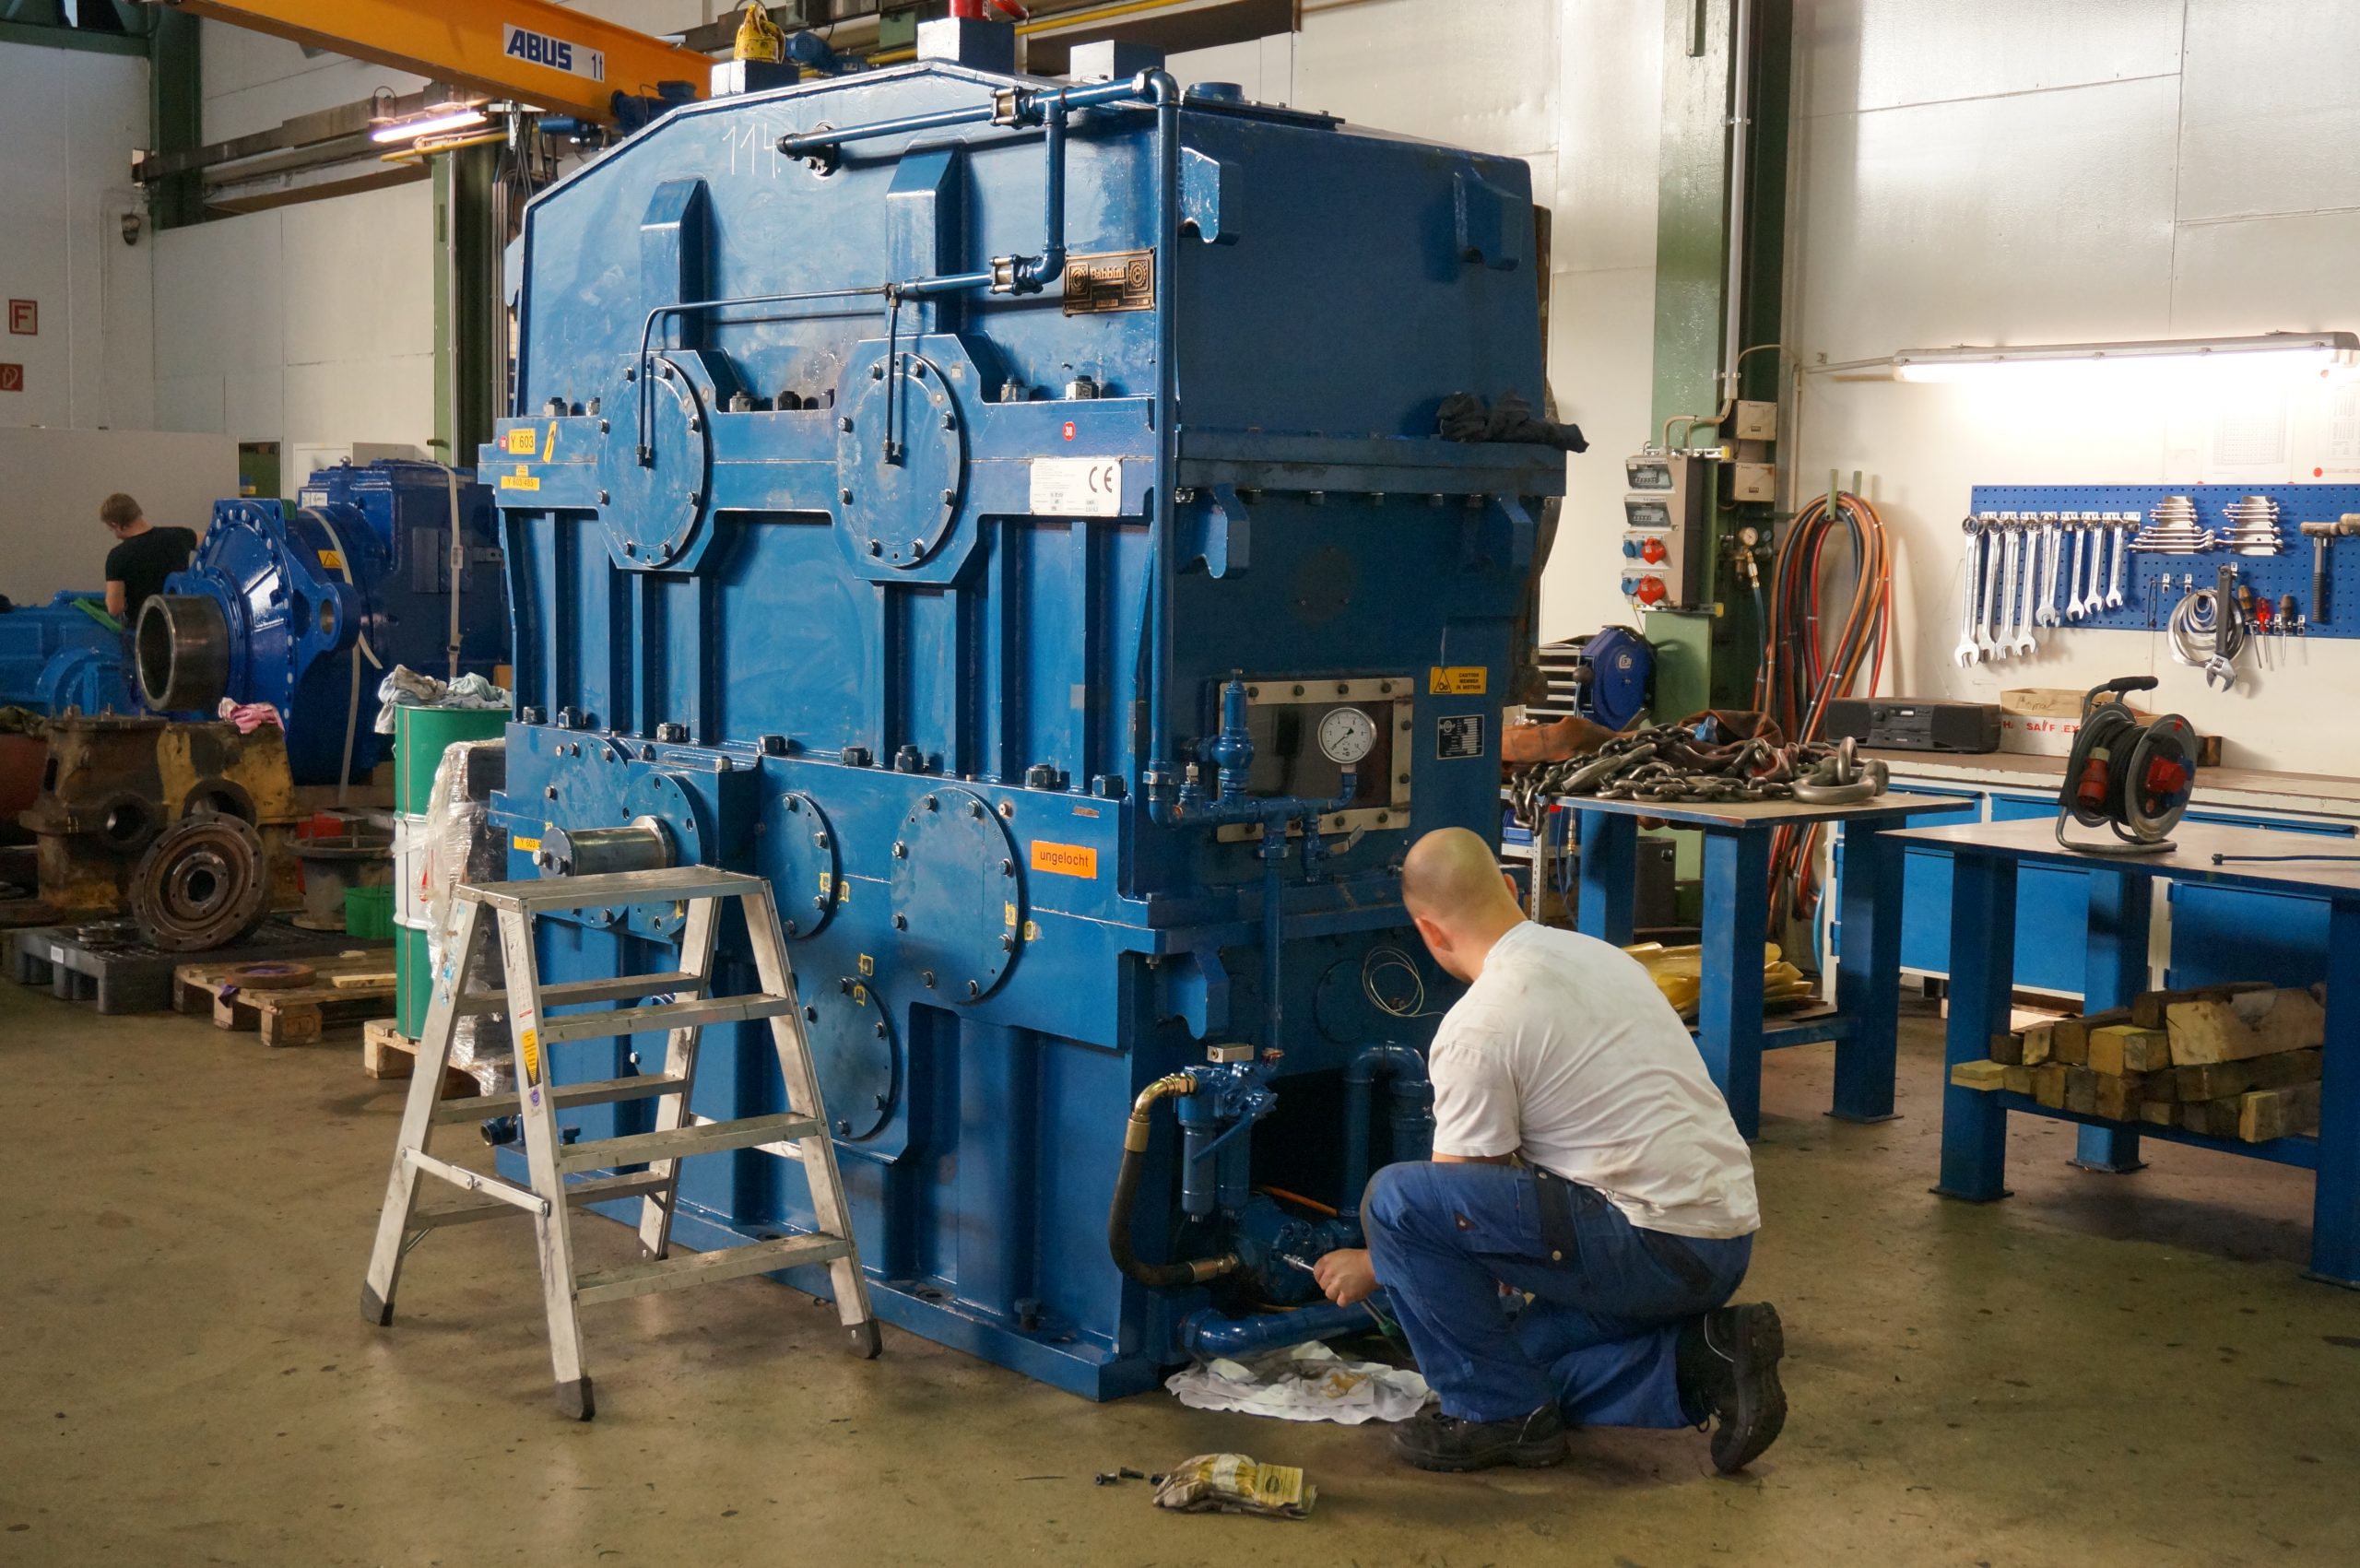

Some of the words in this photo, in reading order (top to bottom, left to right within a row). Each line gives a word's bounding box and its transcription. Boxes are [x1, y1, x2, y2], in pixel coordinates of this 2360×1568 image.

[506, 29, 572, 71] ABUS
[14, 305, 32, 329] F
[511, 435, 516, 449] Y
[519, 435, 534, 449] 603
[1089, 466, 1113, 493] CE
[1040, 851, 1089, 867] ungelocht
